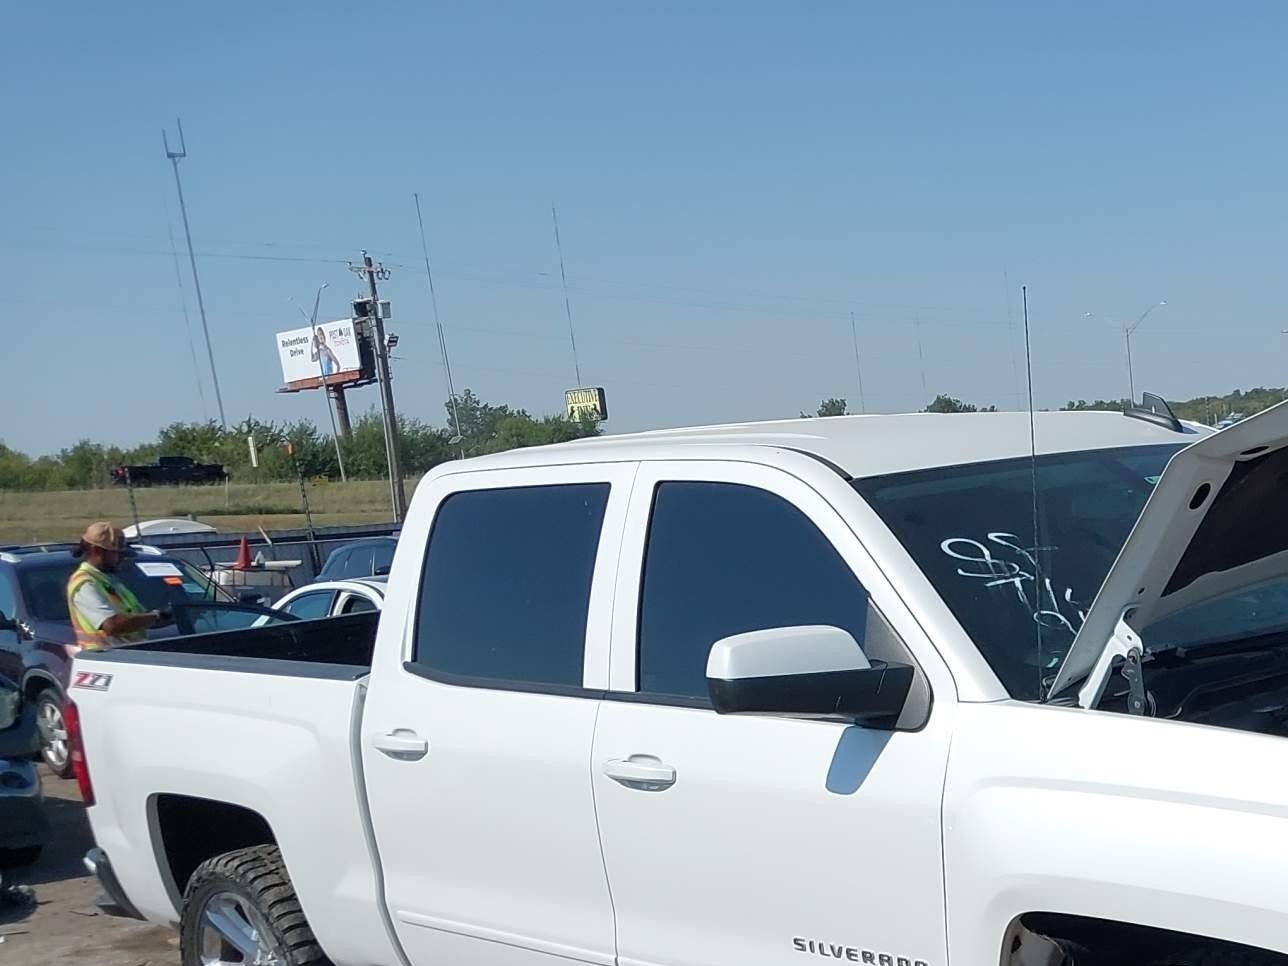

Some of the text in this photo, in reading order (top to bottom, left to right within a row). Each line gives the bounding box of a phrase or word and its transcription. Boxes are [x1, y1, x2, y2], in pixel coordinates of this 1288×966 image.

[281, 336, 309, 348] Relentless
[289, 348, 305, 358] Drive
[73, 671, 113, 691] Z71
